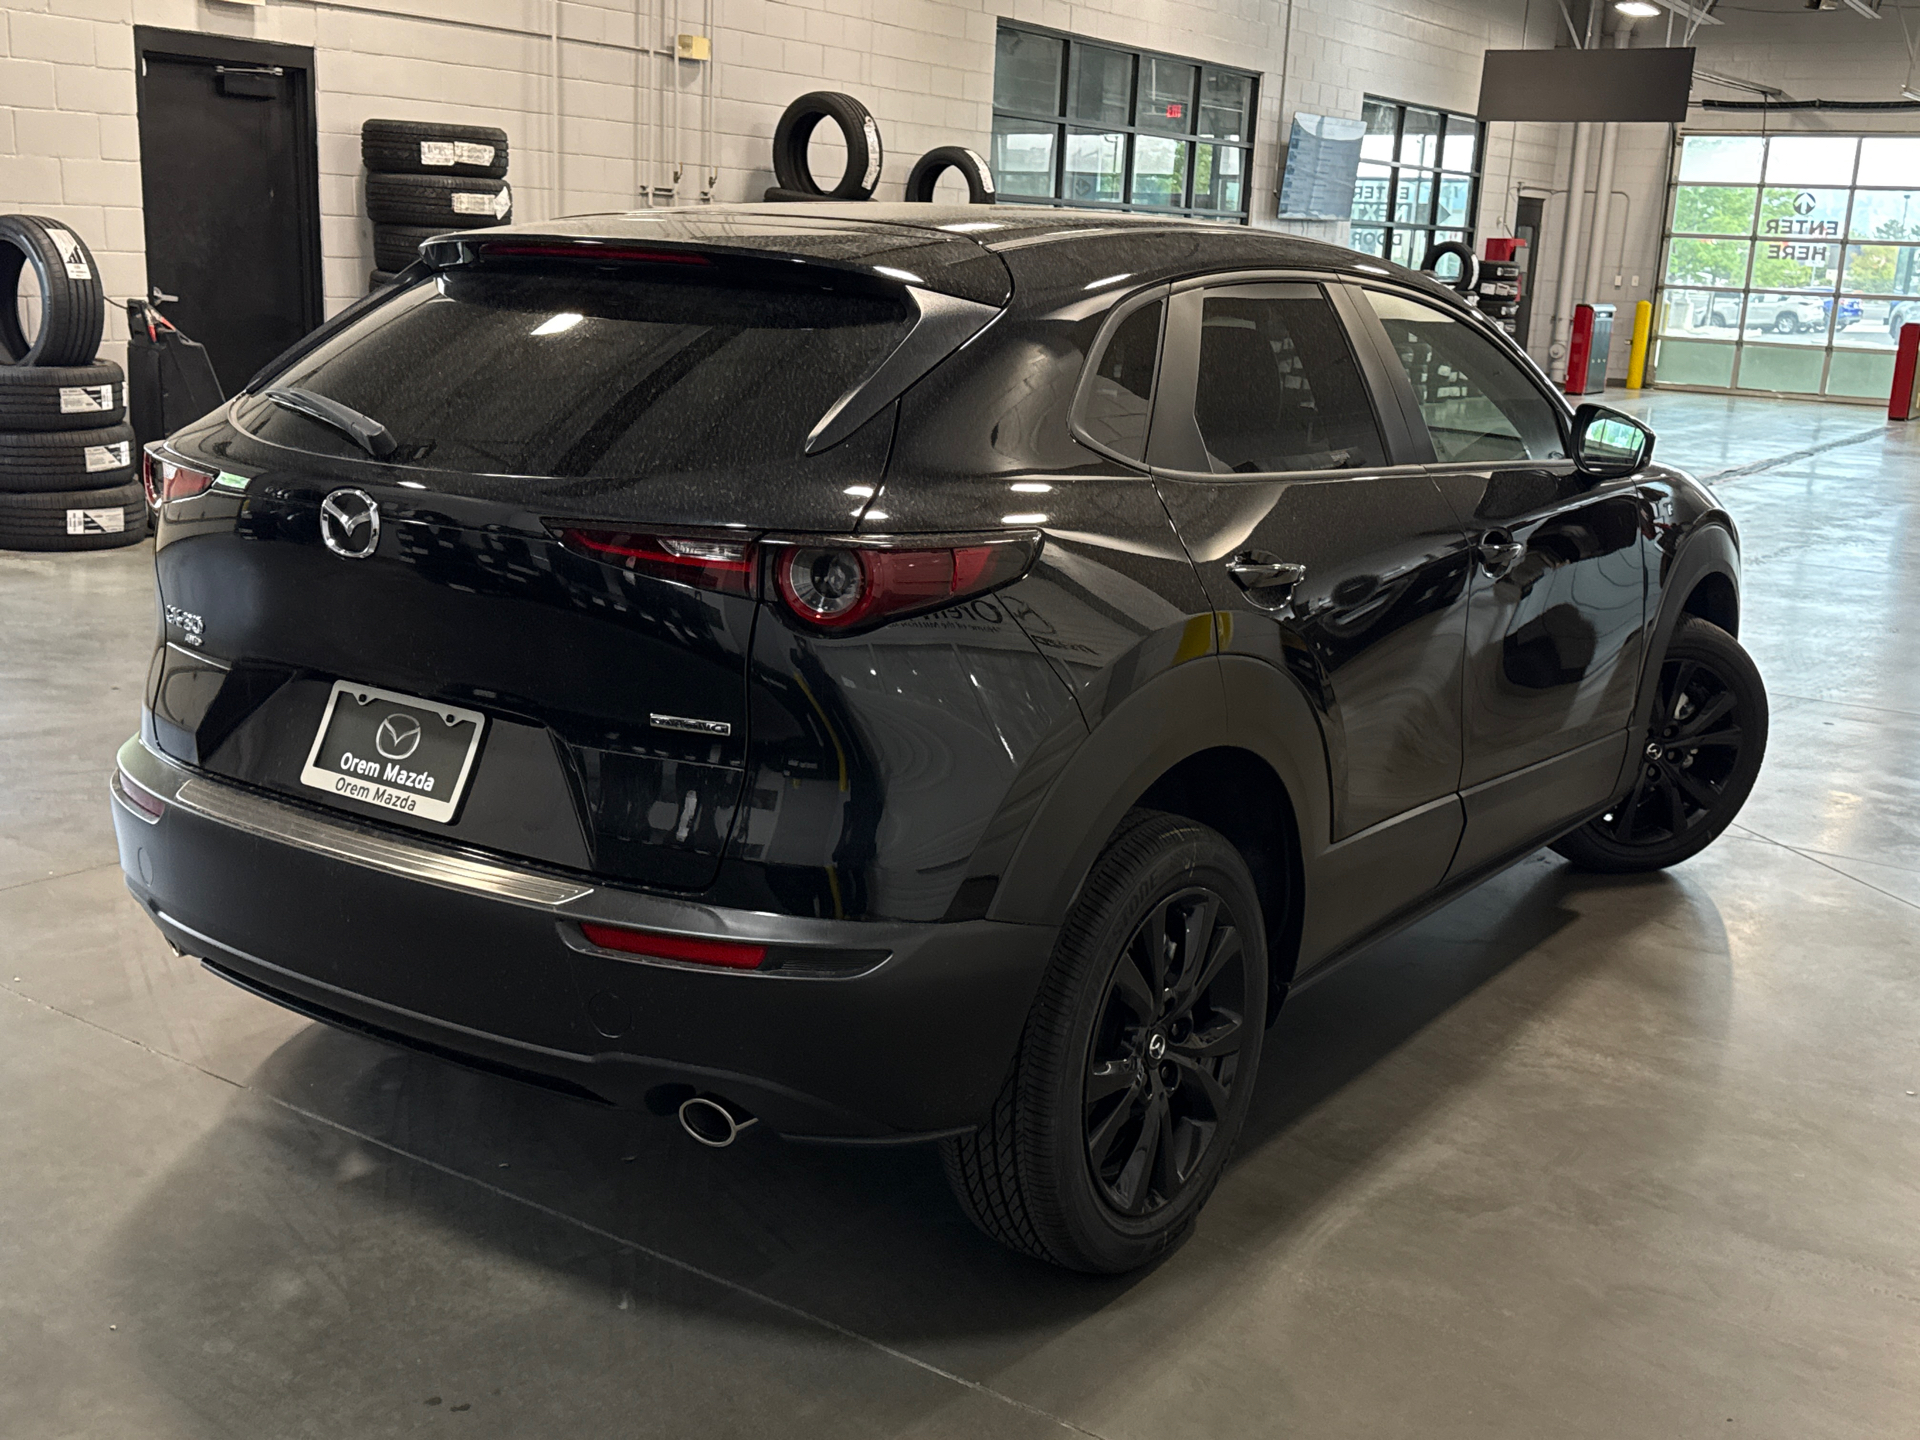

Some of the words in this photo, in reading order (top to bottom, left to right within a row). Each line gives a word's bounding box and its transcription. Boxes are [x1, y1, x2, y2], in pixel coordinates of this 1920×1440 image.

[340, 752, 381, 778] Orem
[383, 762, 435, 792] Mazda
[335, 777, 371, 799] Orem
[372, 787, 417, 812] Mazda
